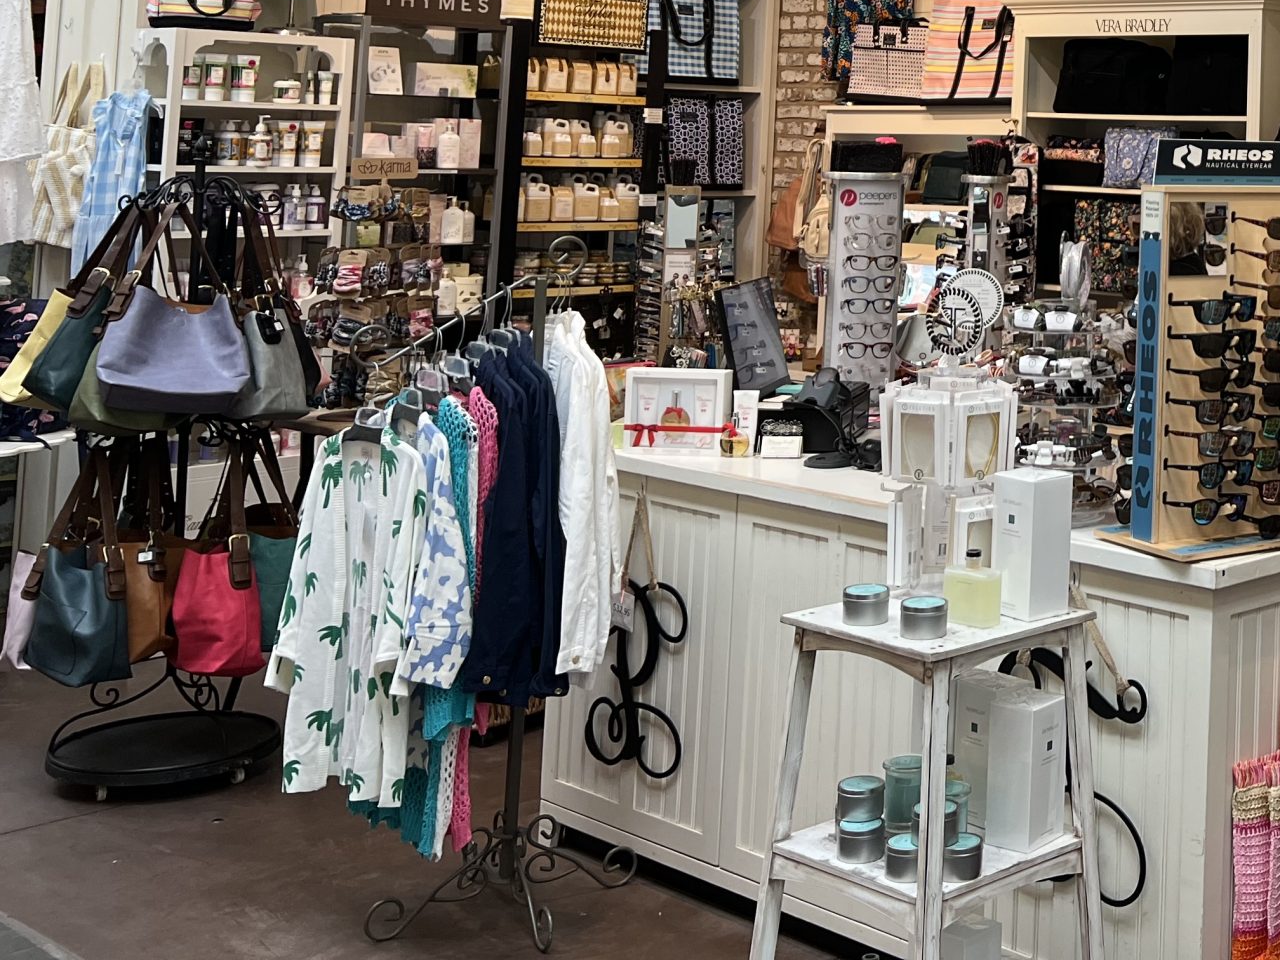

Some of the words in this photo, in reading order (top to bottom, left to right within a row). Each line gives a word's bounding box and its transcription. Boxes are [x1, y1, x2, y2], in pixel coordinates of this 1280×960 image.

[1095, 19, 1122, 33] VERA
[1125, 17, 1173, 33] BRADLEY
[1206, 148, 1274, 161] RHEOS
[378, 159, 411, 177] karma
[1205, 161, 1239, 169] NAUTICAL
[1241, 161, 1272, 169] EYEWEAR
[859, 191, 897, 201] peepers
[1137, 269, 1158, 456] RHEOS
